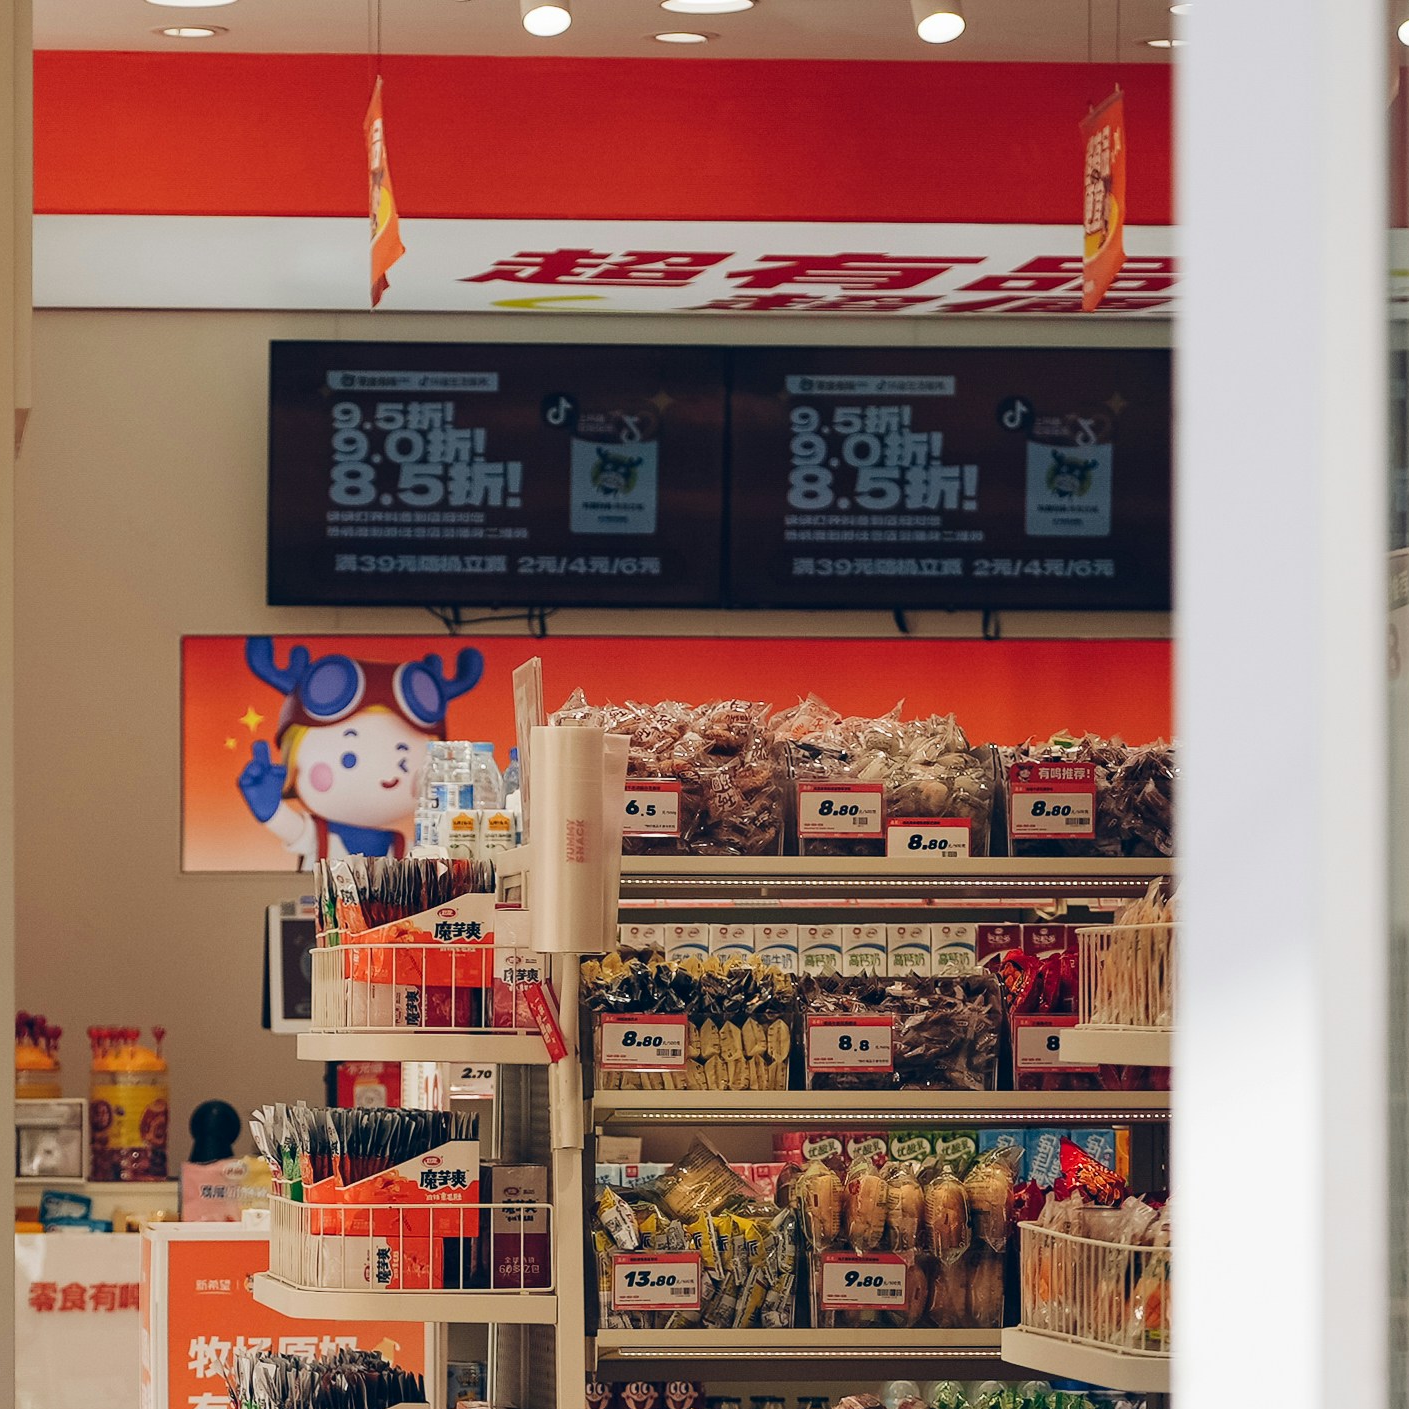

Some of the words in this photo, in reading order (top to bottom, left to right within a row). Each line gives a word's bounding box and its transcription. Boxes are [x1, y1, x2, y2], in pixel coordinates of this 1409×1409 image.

[329, 461, 522, 508] 8.5折!
[787, 464, 978, 511] 8.5折!
[1039, 767, 1091, 780] 有鸣推荐!
[818, 800, 859, 816] 8.80
[1031, 800, 1071, 816] 8.80
[576, 819, 584, 863] SNACK
[908, 834, 948, 850] 8.80
[434, 921, 483, 941] 魔芋爽
[622, 1031, 662, 1047] 8.80
[839, 1035, 869, 1051] 8.8
[461, 1067, 491, 1078] 2.70
[420, 1169, 468, 1189] 魔芋爽
[376, 1247, 391, 1284] 魔芋爽
[196, 1279, 231, 1292] 新希望
[624, 1271, 676, 1287] 13.80
[845, 1271, 883, 1287] 9.80
